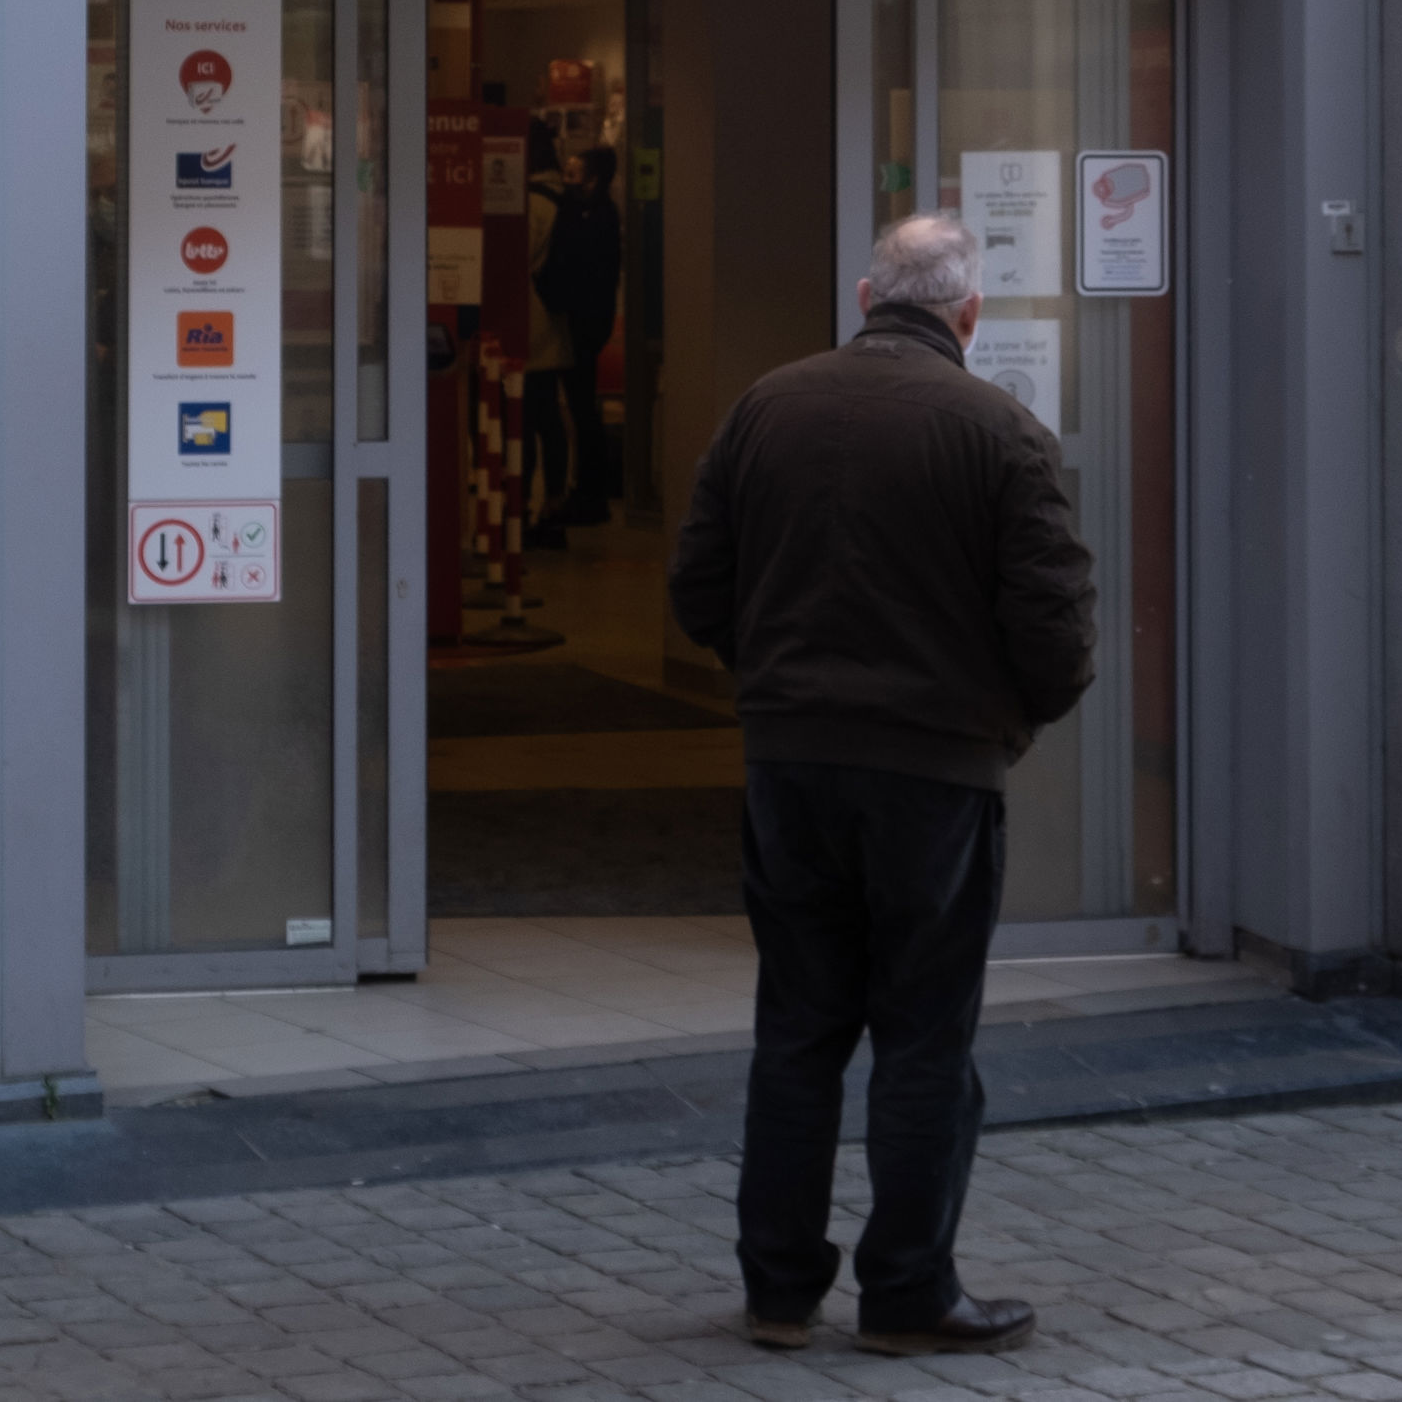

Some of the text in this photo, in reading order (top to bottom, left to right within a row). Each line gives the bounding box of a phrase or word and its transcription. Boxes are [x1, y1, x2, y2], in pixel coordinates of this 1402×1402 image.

[165, 19, 247, 33] Nos services
[186, 322, 224, 345] Ria
